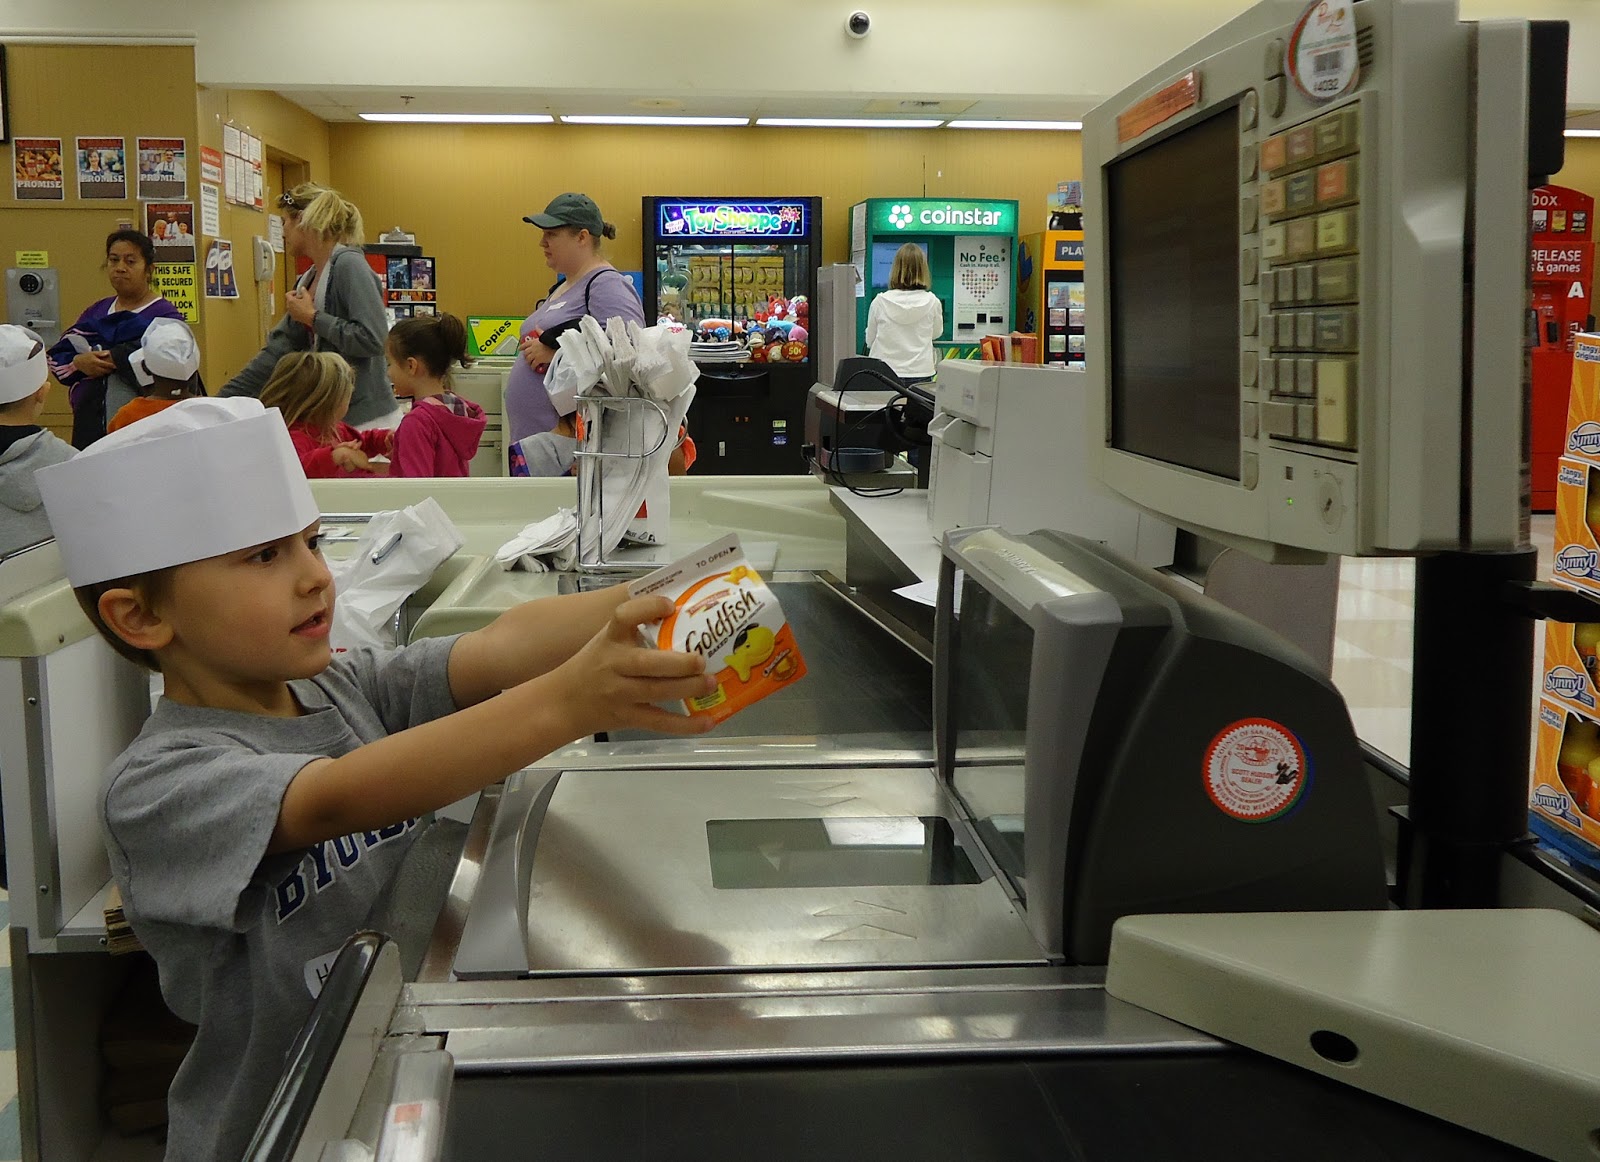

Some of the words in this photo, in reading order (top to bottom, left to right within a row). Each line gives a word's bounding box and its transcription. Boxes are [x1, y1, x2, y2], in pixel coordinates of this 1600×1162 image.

[81, 174, 124, 183] PROMISE
[18, 181, 62, 189] PROMISE
[920, 204, 1002, 226] coinstar
[960, 252, 977, 263] No
[154, 266, 171, 275] THIS
[172, 266, 191, 275] SAFE
[1546, 263, 1581, 275] games
[161, 277, 194, 287] SECURED
[161, 289, 180, 298] WITH
[181, 289, 187, 298] A
[1567, 281, 1585, 298] A
[174, 300, 194, 309] LOCK
[480, 320, 512, 352] copies
[1578, 343, 1598, 354] Tangy
[1562, 467, 1581, 479] Tangy
[1559, 474, 1585, 486] Original
[696, 560, 707, 568] TO
[708, 549, 729, 563] OPEN
[685, 588, 758, 656] Goldfish
